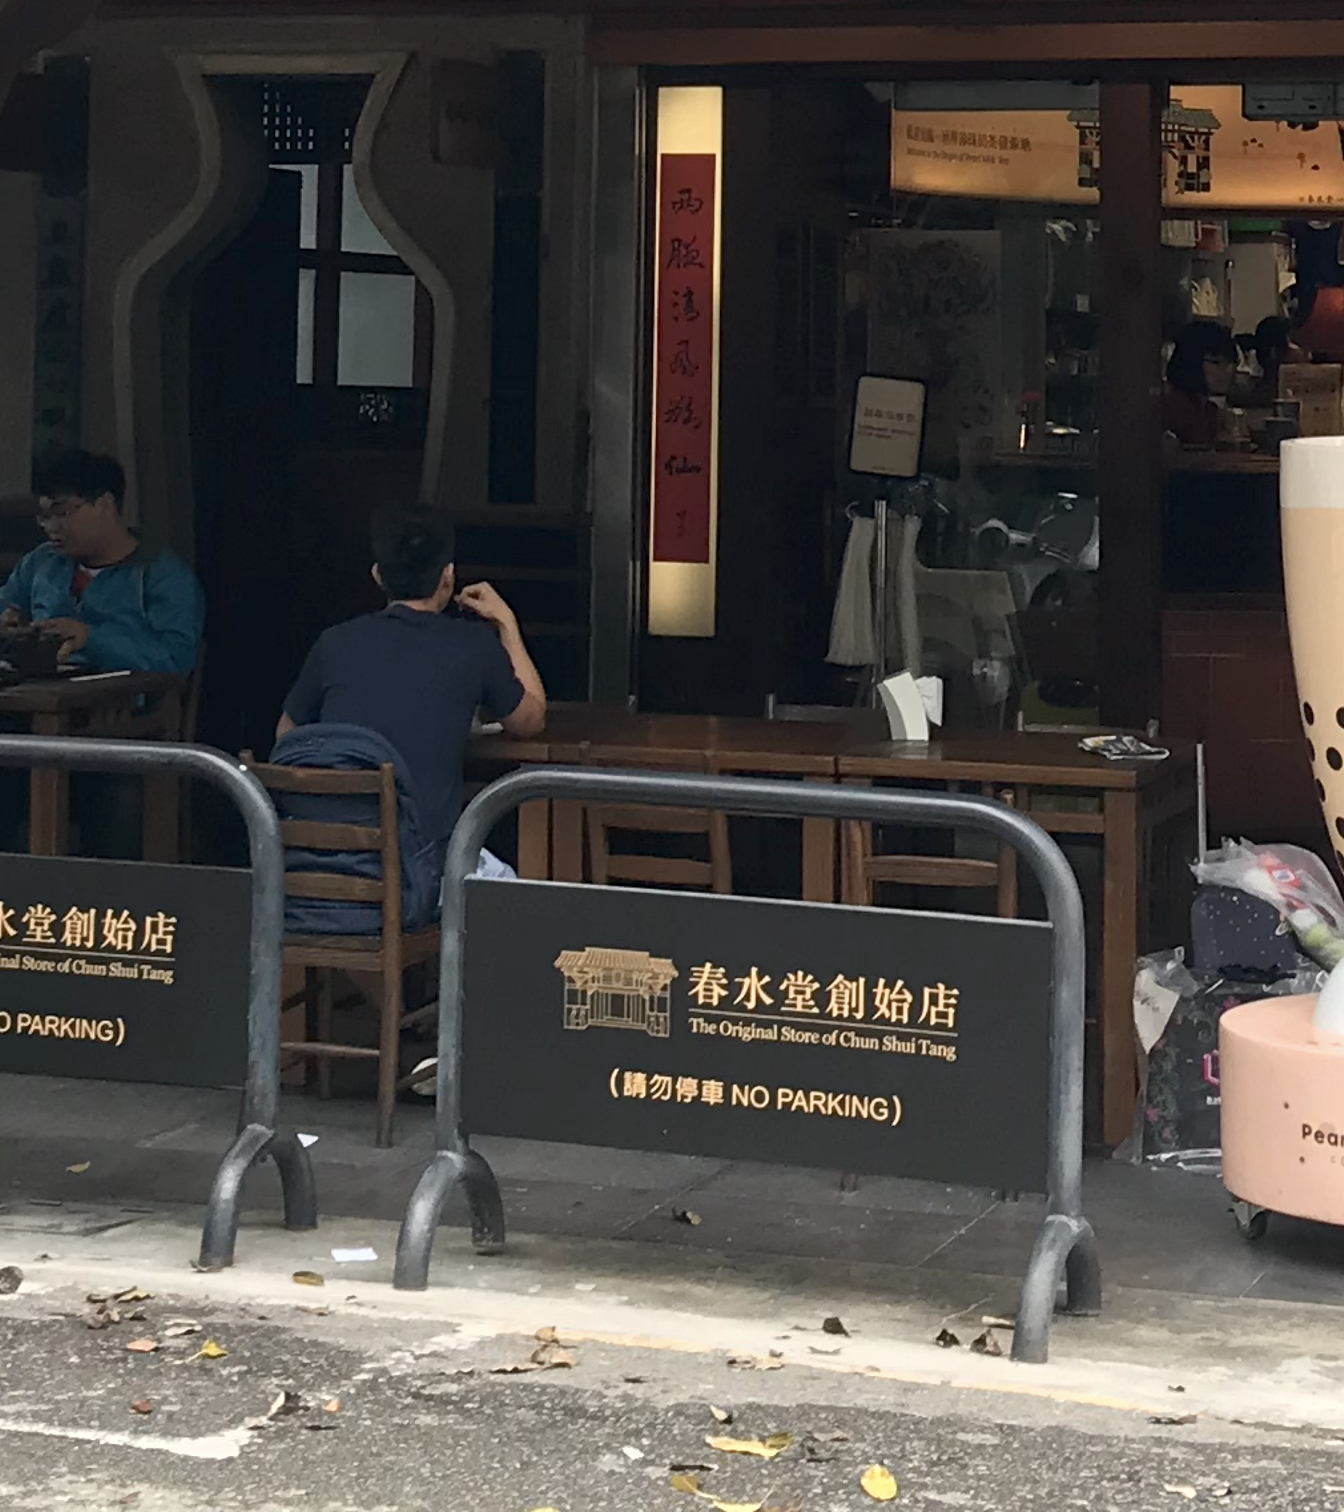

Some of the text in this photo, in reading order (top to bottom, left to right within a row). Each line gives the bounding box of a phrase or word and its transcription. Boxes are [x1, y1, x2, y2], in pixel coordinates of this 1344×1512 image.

[22, 955, 55, 972] Store
[57, 958, 71, 973] of
[72, 958, 106, 976] Chun
[109, 962, 138, 979] Shui
[140, 964, 174, 984] Tang
[688, 962, 960, 1028] 春水堂創始店
[688, 1017, 957, 1062] The Original Store of Chun Shui Tang
[731, 1084, 770, 1109] NO
